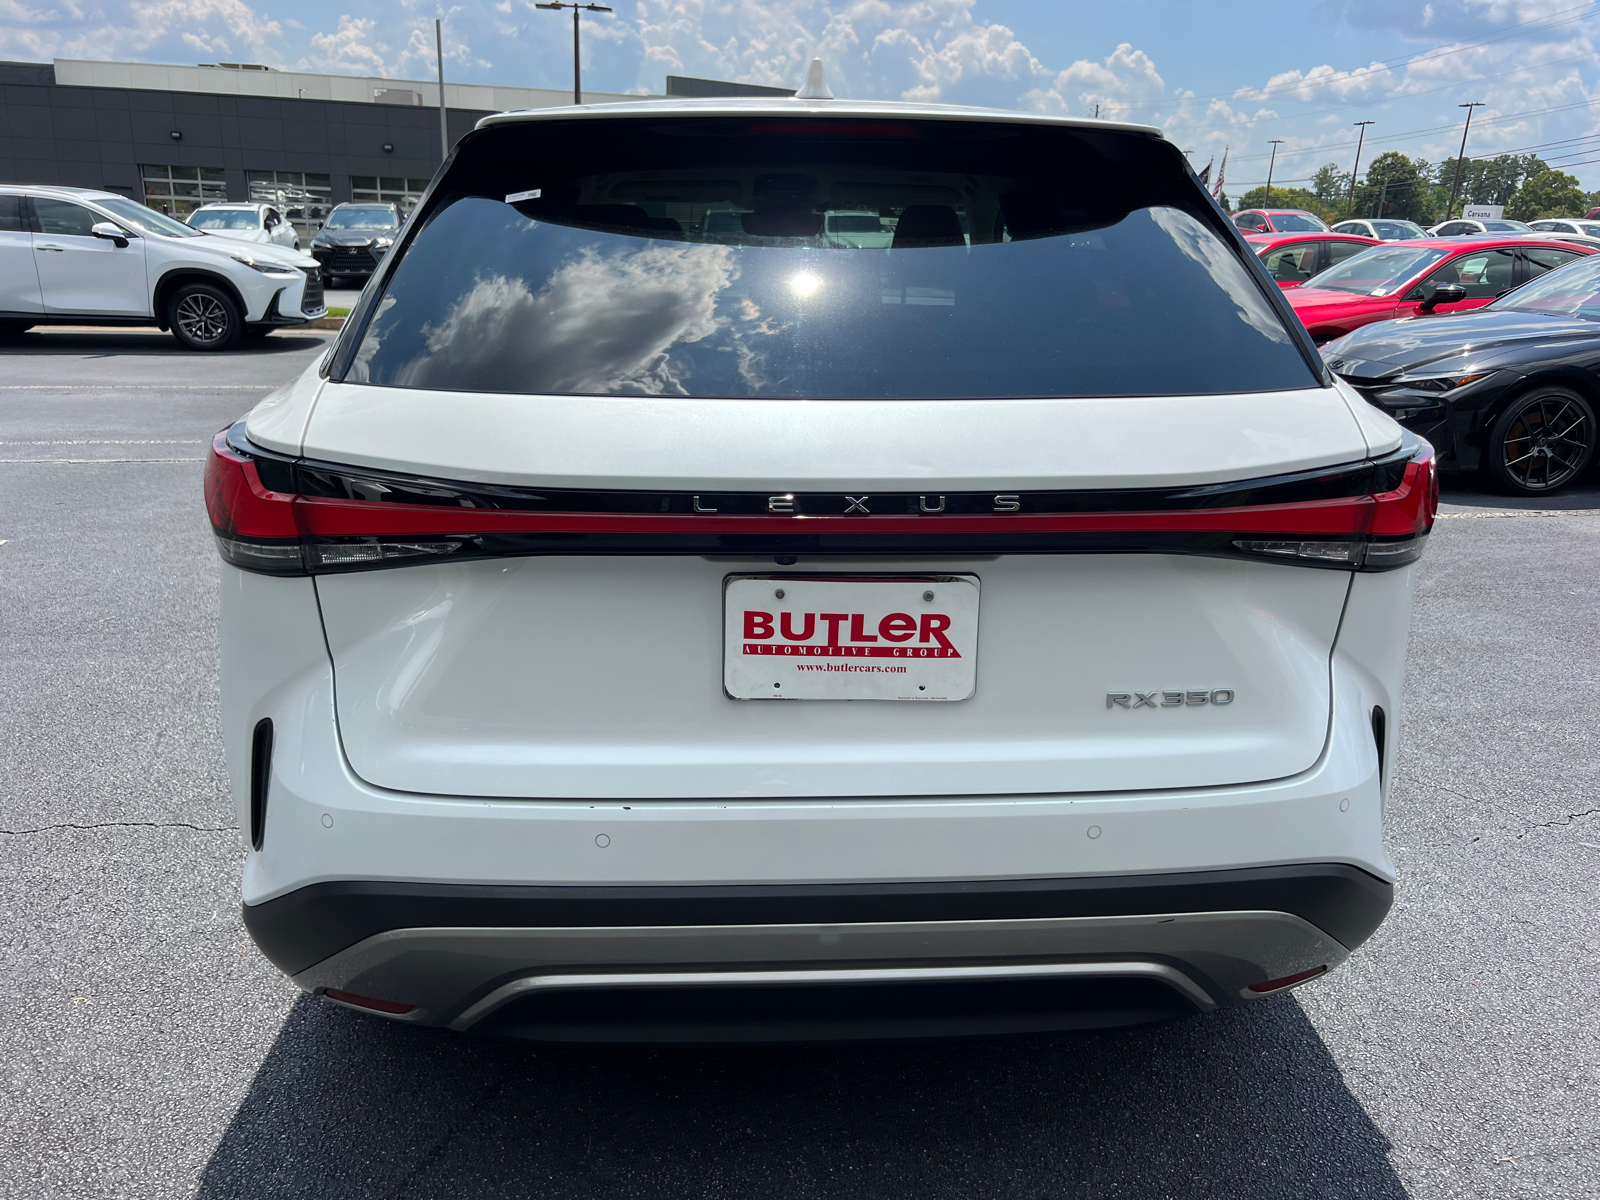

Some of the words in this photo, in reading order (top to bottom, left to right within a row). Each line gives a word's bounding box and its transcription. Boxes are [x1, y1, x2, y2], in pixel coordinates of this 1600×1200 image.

[1467, 210, 1491, 218] Carvana
[693, 495, 1020, 513] LEXUS
[744, 645, 871, 656] AUTOMOTIVE
[893, 648, 954, 657] GROUP
[796, 662, 907, 673] www.butlercars.com
